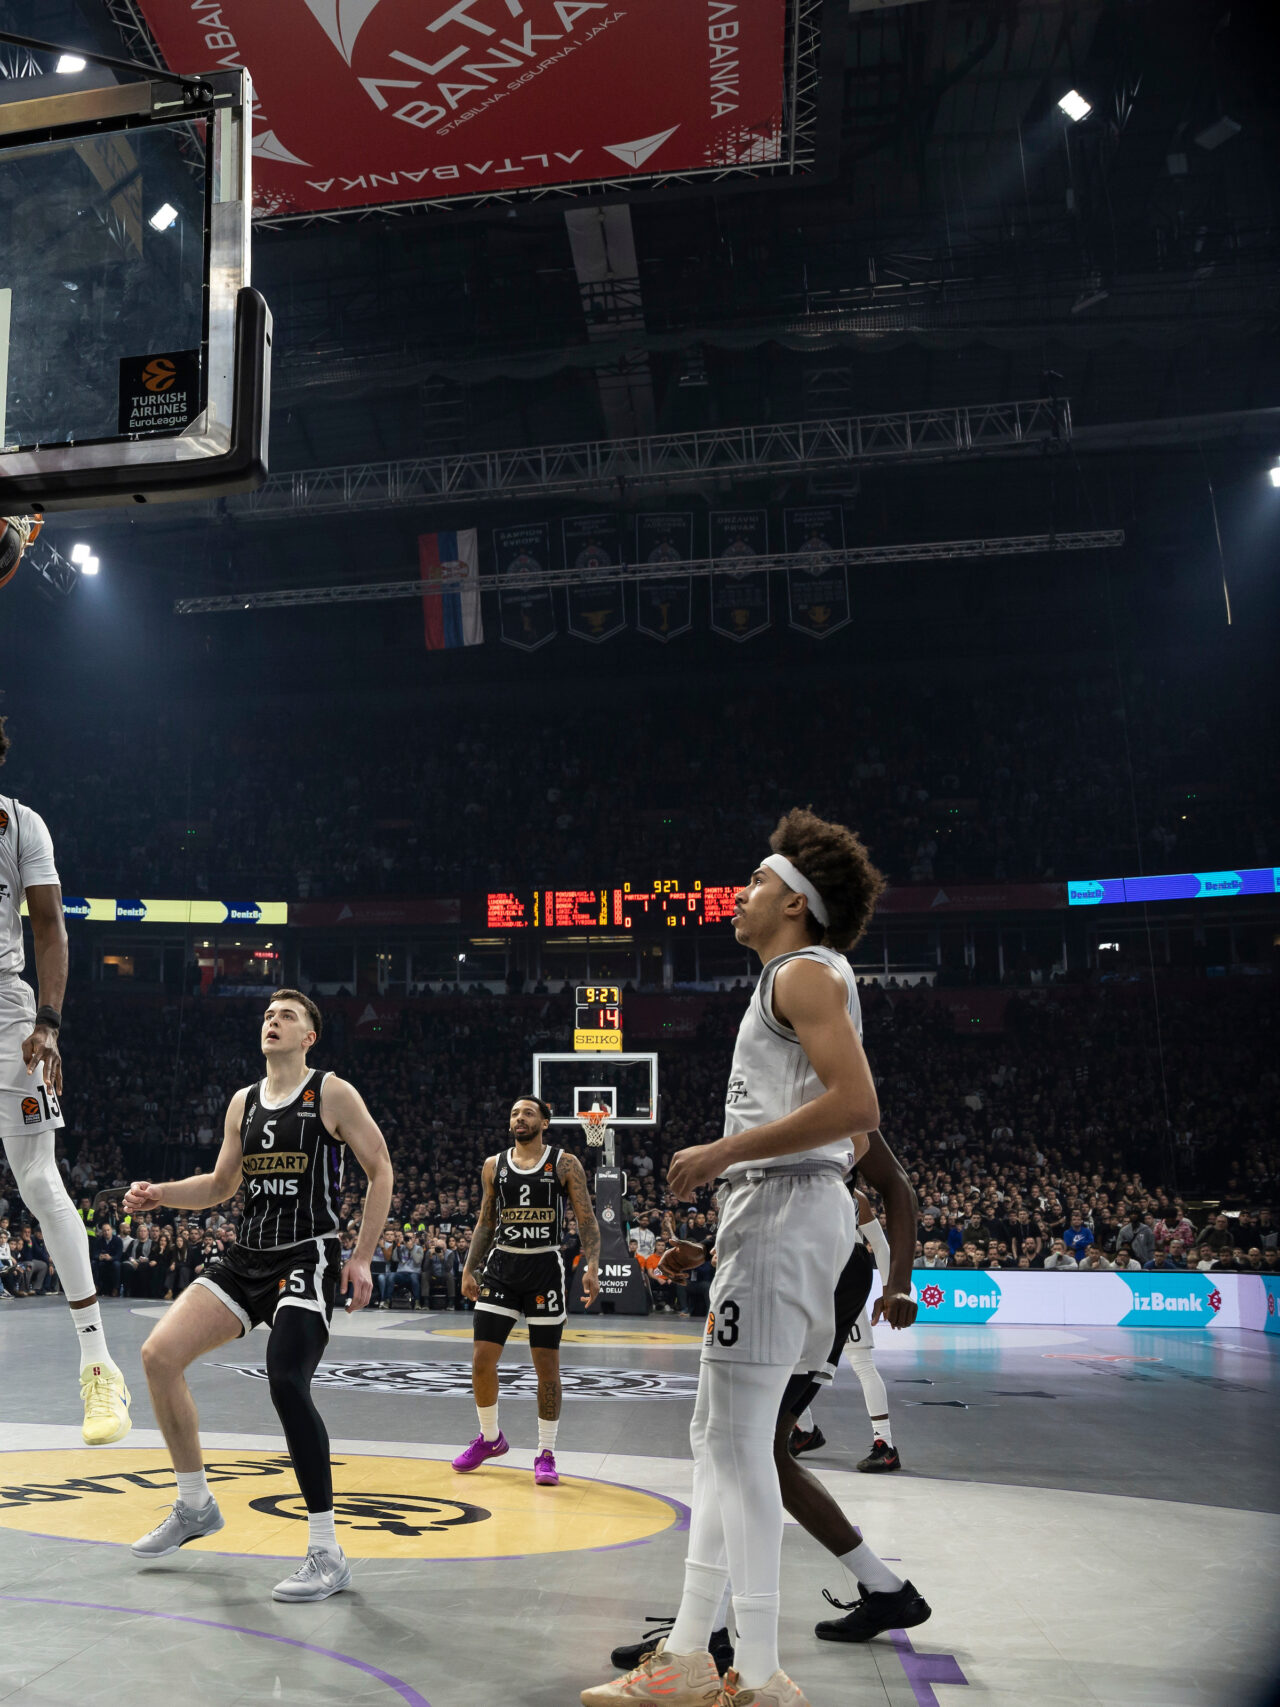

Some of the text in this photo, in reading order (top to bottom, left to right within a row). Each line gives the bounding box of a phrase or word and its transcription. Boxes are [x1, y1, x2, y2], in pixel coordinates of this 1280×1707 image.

[508, 46, 578, 90] SIGURNA
[582, 10, 627, 42] JAKA
[391, 1, 609, 129] BANKA
[131, 391, 187, 407] TURKISH
[130, 402, 187, 418] AIRLINES
[129, 415, 188, 428] EuroLeague
[624, 882, 631, 893] 0
[694, 880, 702, 891] 0
[687, 898, 696, 911] 0
[624, 916, 632, 928] 0
[586, 988, 618, 1003] 9:27
[600, 1009, 619, 1028] 14
[575, 1035, 619, 1045] SEIKO
[261, 1119, 277, 1150] 5
[243, 1155, 307, 1171] MOZZART
[263, 1179, 299, 1196] NIS
[519, 1184, 531, 1206] 2
[502, 1210, 554, 1221] MOZZART
[522, 1226, 550, 1239] NIS
[605, 1264, 632, 1277] NIS
[289, 1268, 306, 1293] 5
[547, 1289, 559, 1312] 2
